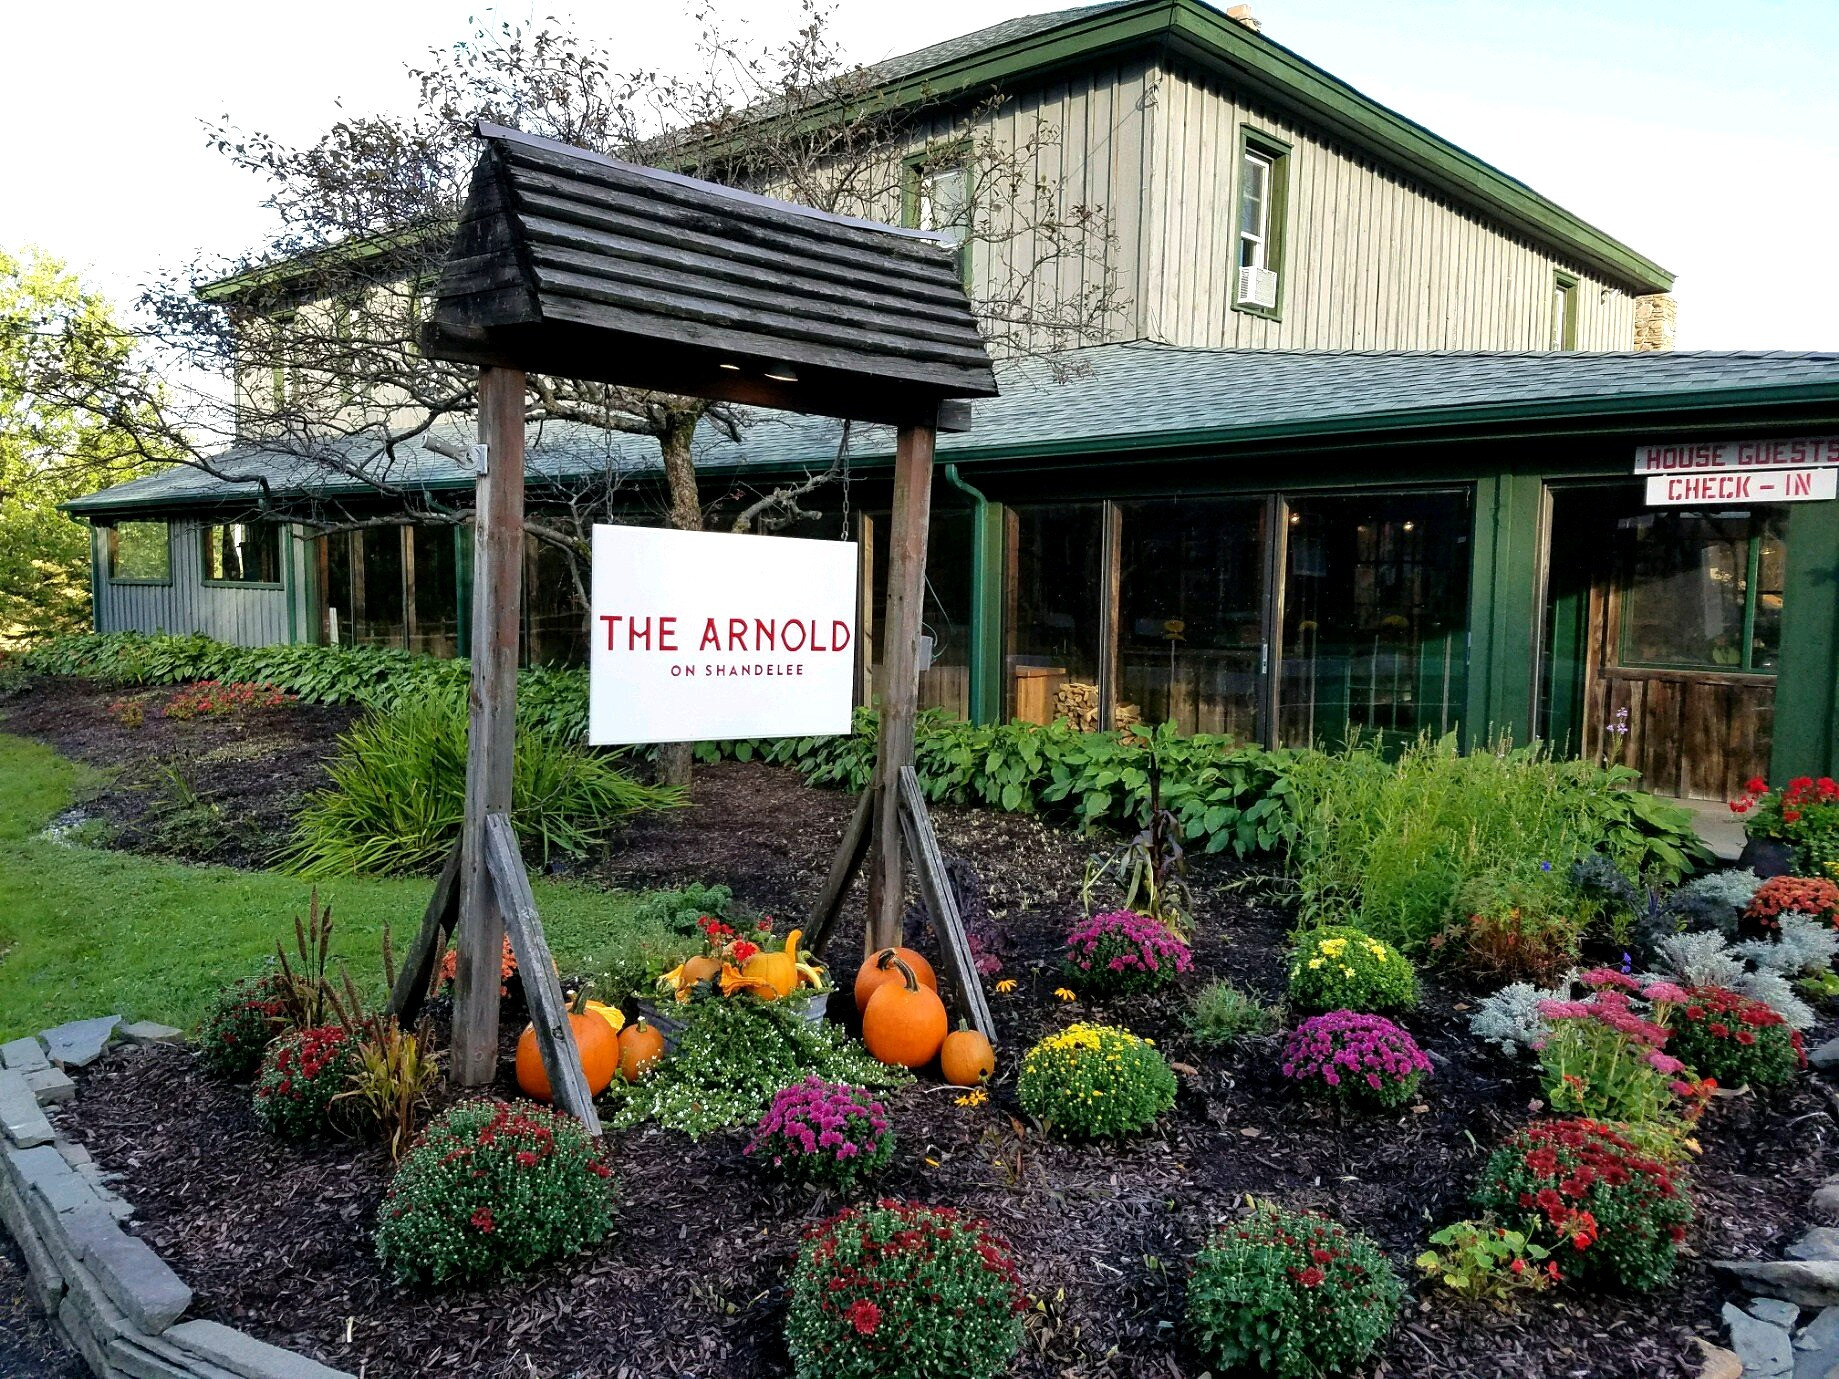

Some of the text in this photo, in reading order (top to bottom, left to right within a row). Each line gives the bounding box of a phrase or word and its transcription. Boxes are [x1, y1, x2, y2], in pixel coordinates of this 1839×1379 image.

[1646, 438, 1839, 470] HOUSE GUESTS
[1668, 475, 1751, 501] CHECK
[1785, 473, 1812, 497] IN
[600, 615, 851, 652] THE ARNOLD
[671, 664, 804, 677] ON SHANDELEE
